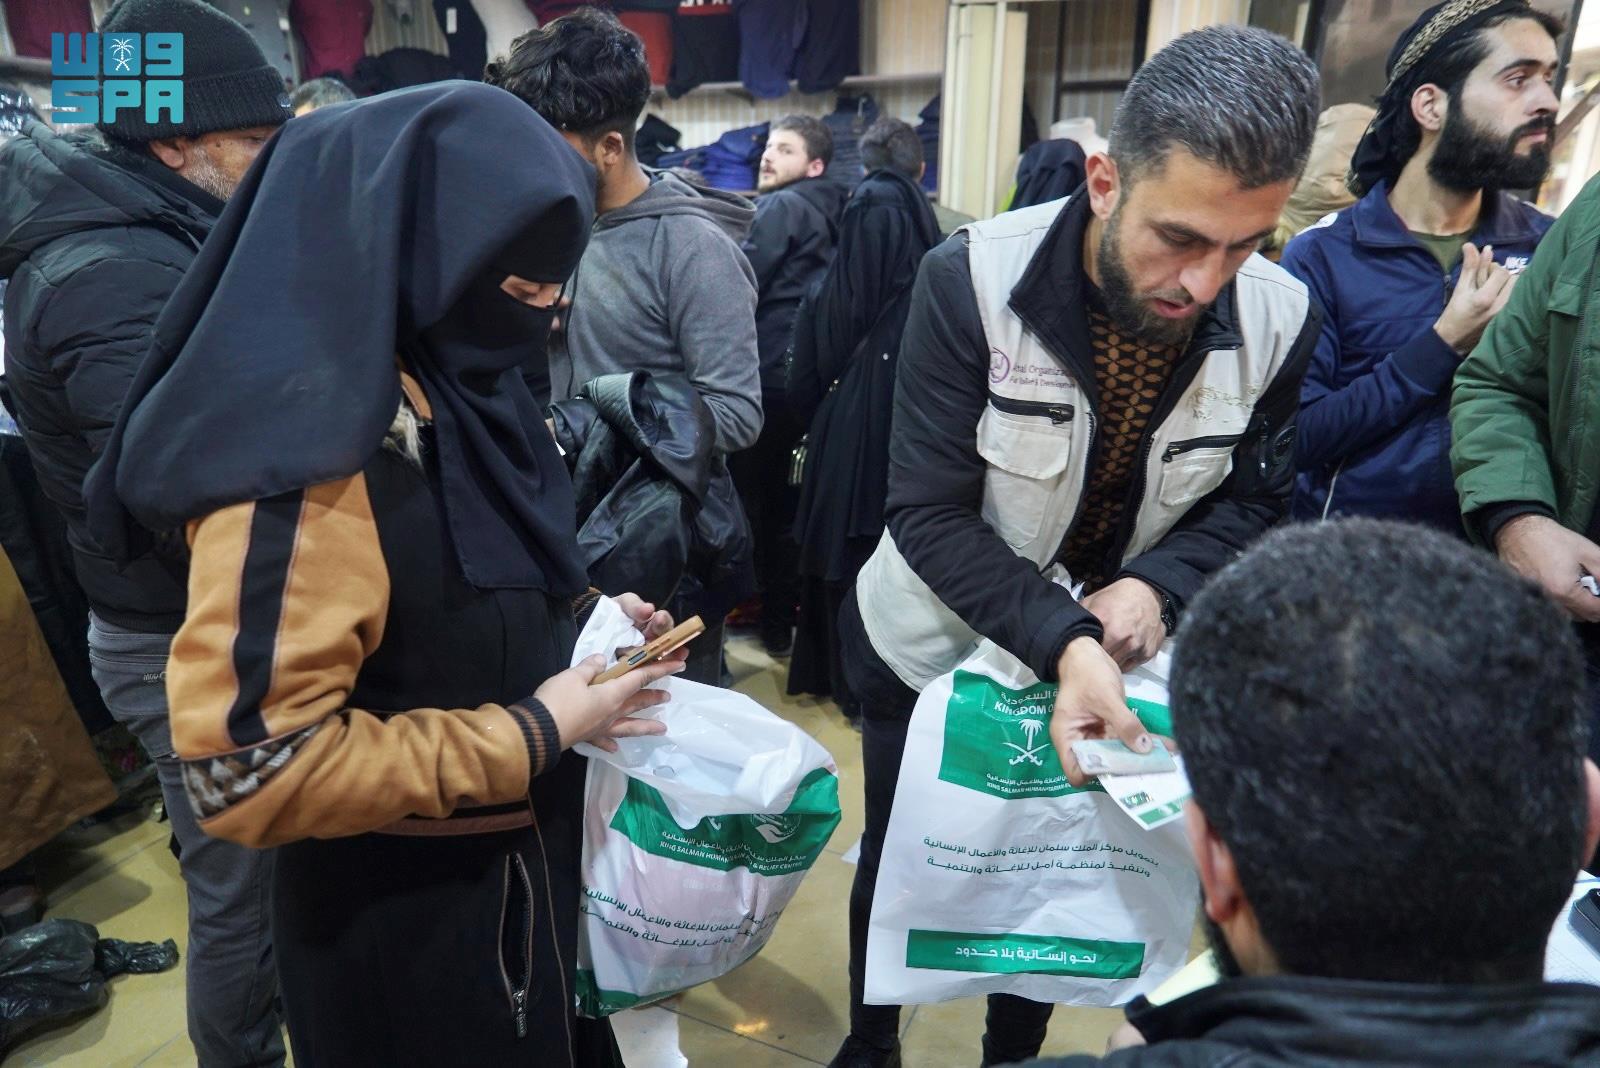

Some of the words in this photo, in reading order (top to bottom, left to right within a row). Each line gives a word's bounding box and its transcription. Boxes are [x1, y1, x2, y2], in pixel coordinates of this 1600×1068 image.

[1505, 256, 1528, 269] NIKE
[1000, 690, 1051, 705] السعودية
[994, 701, 1047, 716] KINGDOM
[660, 841, 677, 852] KING
[677, 846, 706, 858] SALMAN
[923, 836, 967, 855] الإنسانية
[1039, 843, 1070, 853] سلمان
[1071, 843, 1098, 852] الملك
[1100, 843, 1124, 853] مركز
[1125, 849, 1160, 868] بتمويل
[954, 945, 999, 958] حدود
[1000, 947, 1016, 961] بلا
[1016, 946, 1067, 965] إنسانية
[1067, 953, 1096, 965] نحو
